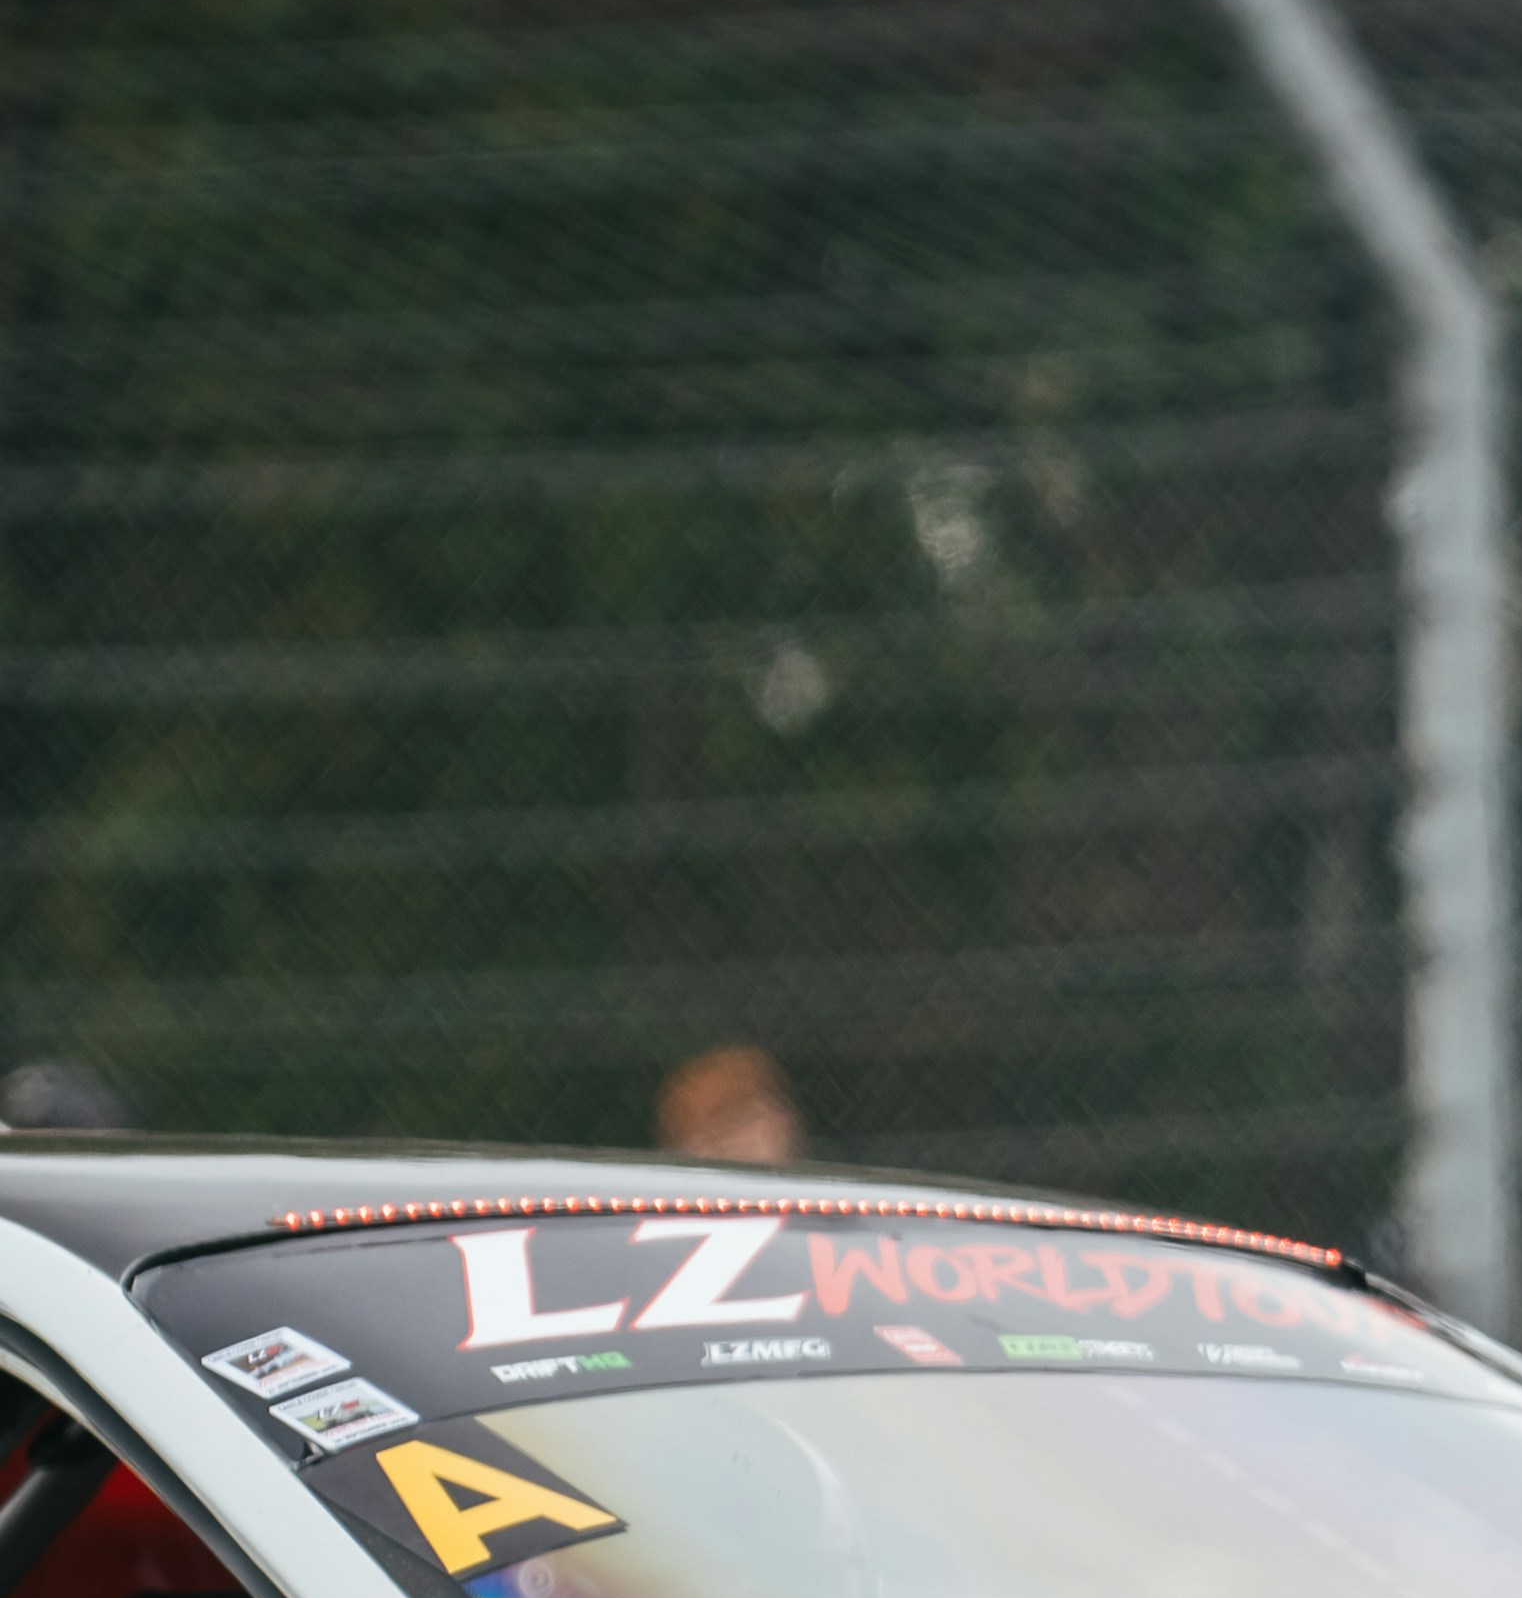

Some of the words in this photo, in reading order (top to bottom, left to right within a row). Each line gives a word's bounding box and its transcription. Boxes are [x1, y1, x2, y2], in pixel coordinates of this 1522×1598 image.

[450, 1215, 810, 1351] LZ
[703, 1338, 830, 1367] LZMFG
[373, 1439, 624, 1575] A
